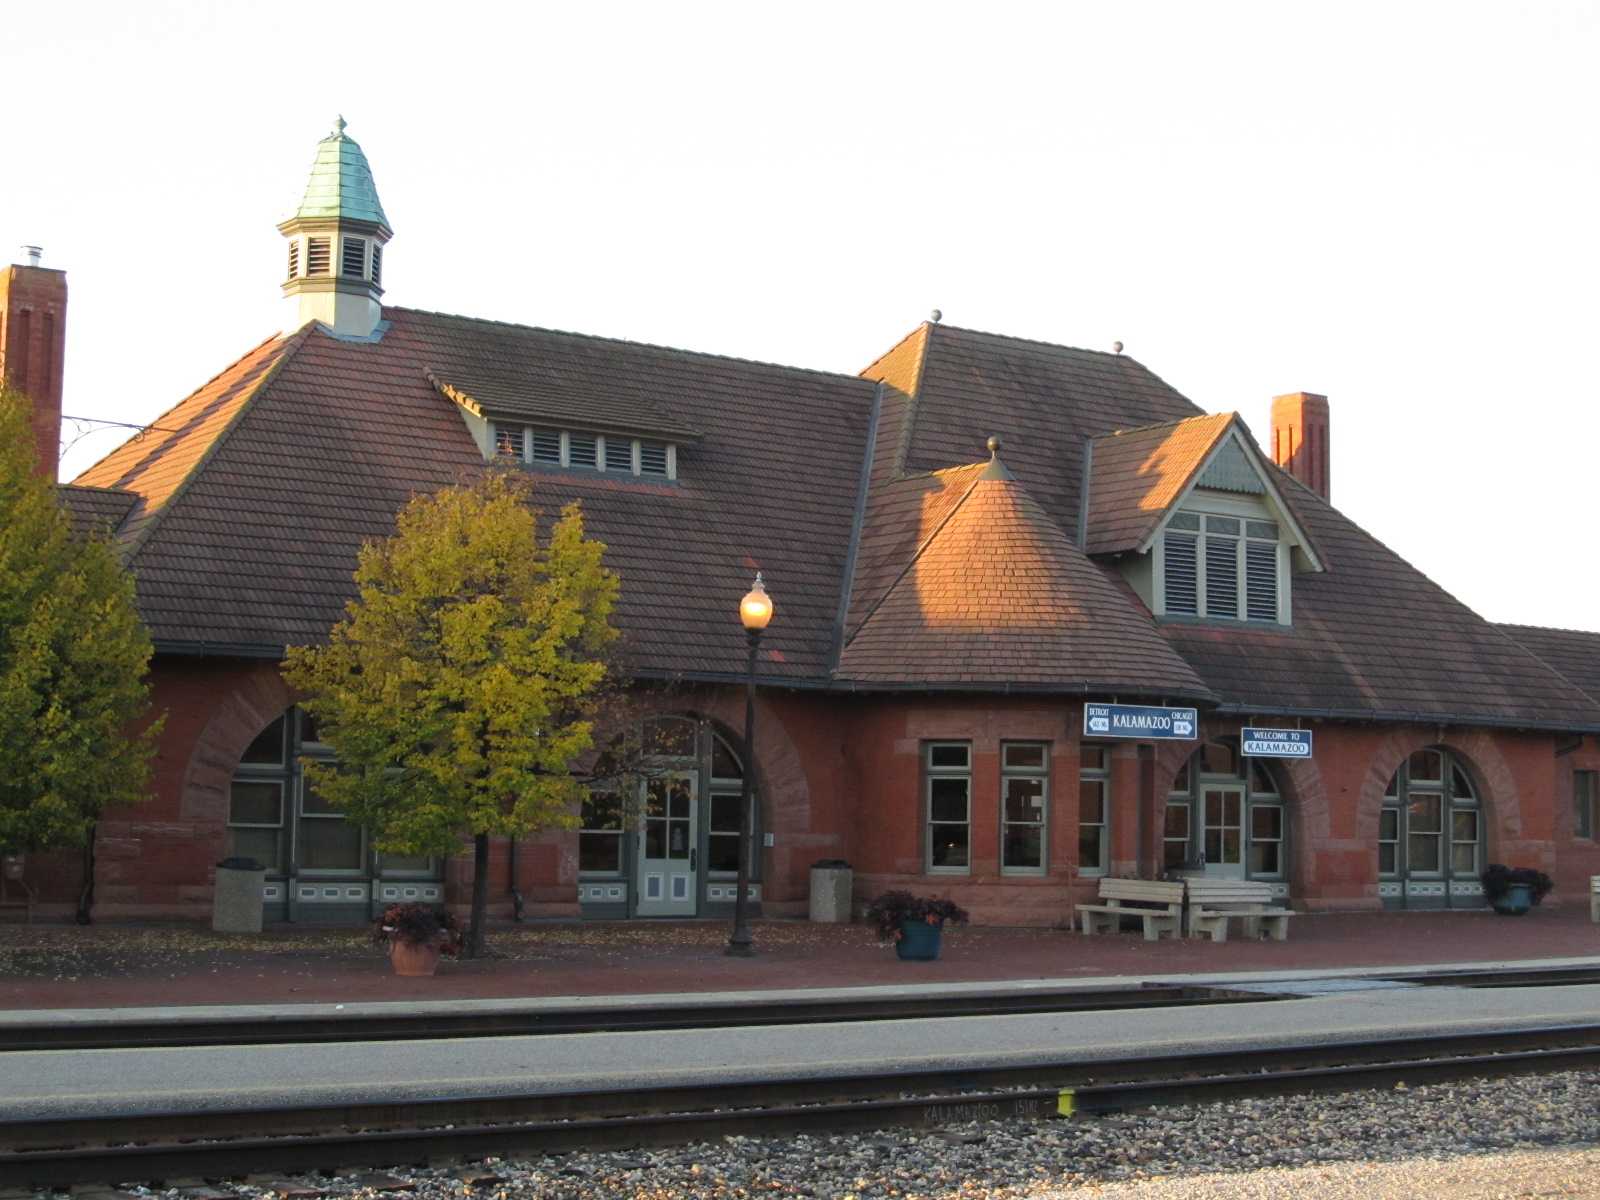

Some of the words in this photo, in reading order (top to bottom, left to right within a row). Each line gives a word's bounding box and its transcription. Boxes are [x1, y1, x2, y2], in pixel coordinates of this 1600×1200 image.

[1089, 707, 1109, 716] DETROIT
[1171, 711, 1193, 720] CHICAGO
[1113, 714, 1170, 730] KALAMAZOO
[1253, 731, 1288, 740] WELCOME
[1291, 733, 1300, 741] TO
[1247, 742, 1305, 753] KALAMAZOO
